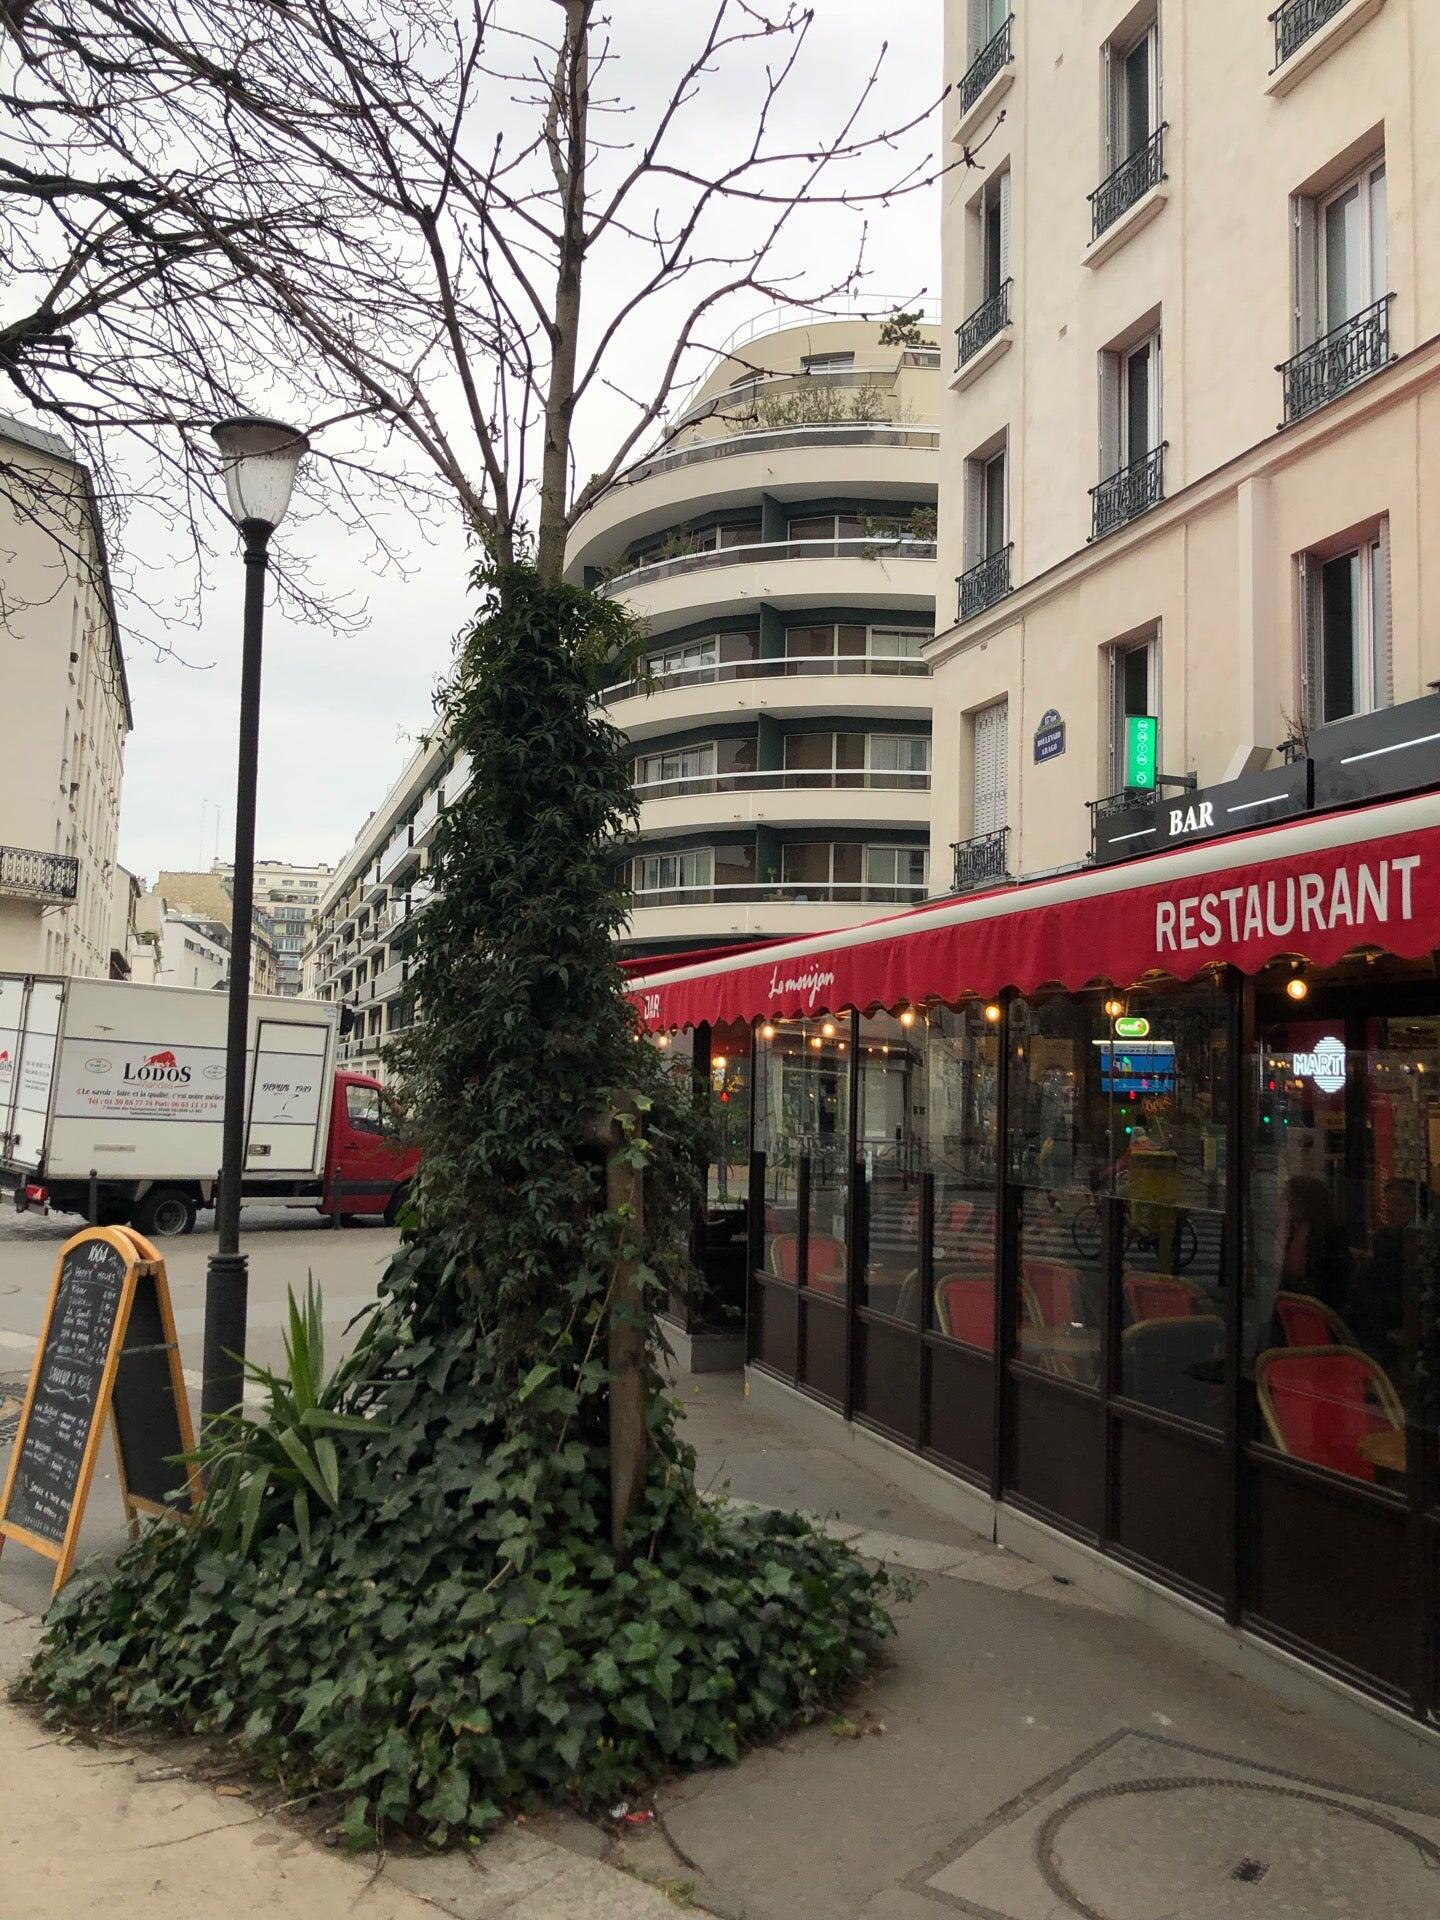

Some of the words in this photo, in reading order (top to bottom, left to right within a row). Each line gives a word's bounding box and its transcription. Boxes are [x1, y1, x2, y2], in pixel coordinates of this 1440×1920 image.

[1041, 743, 1058, 756] ARAGO
[1168, 801, 1214, 836] BAR
[1156, 854, 1420, 952] RESTAURANT
[124, 1062, 192, 1082] LODOS
[88, 1243, 109, 1263] 1664
